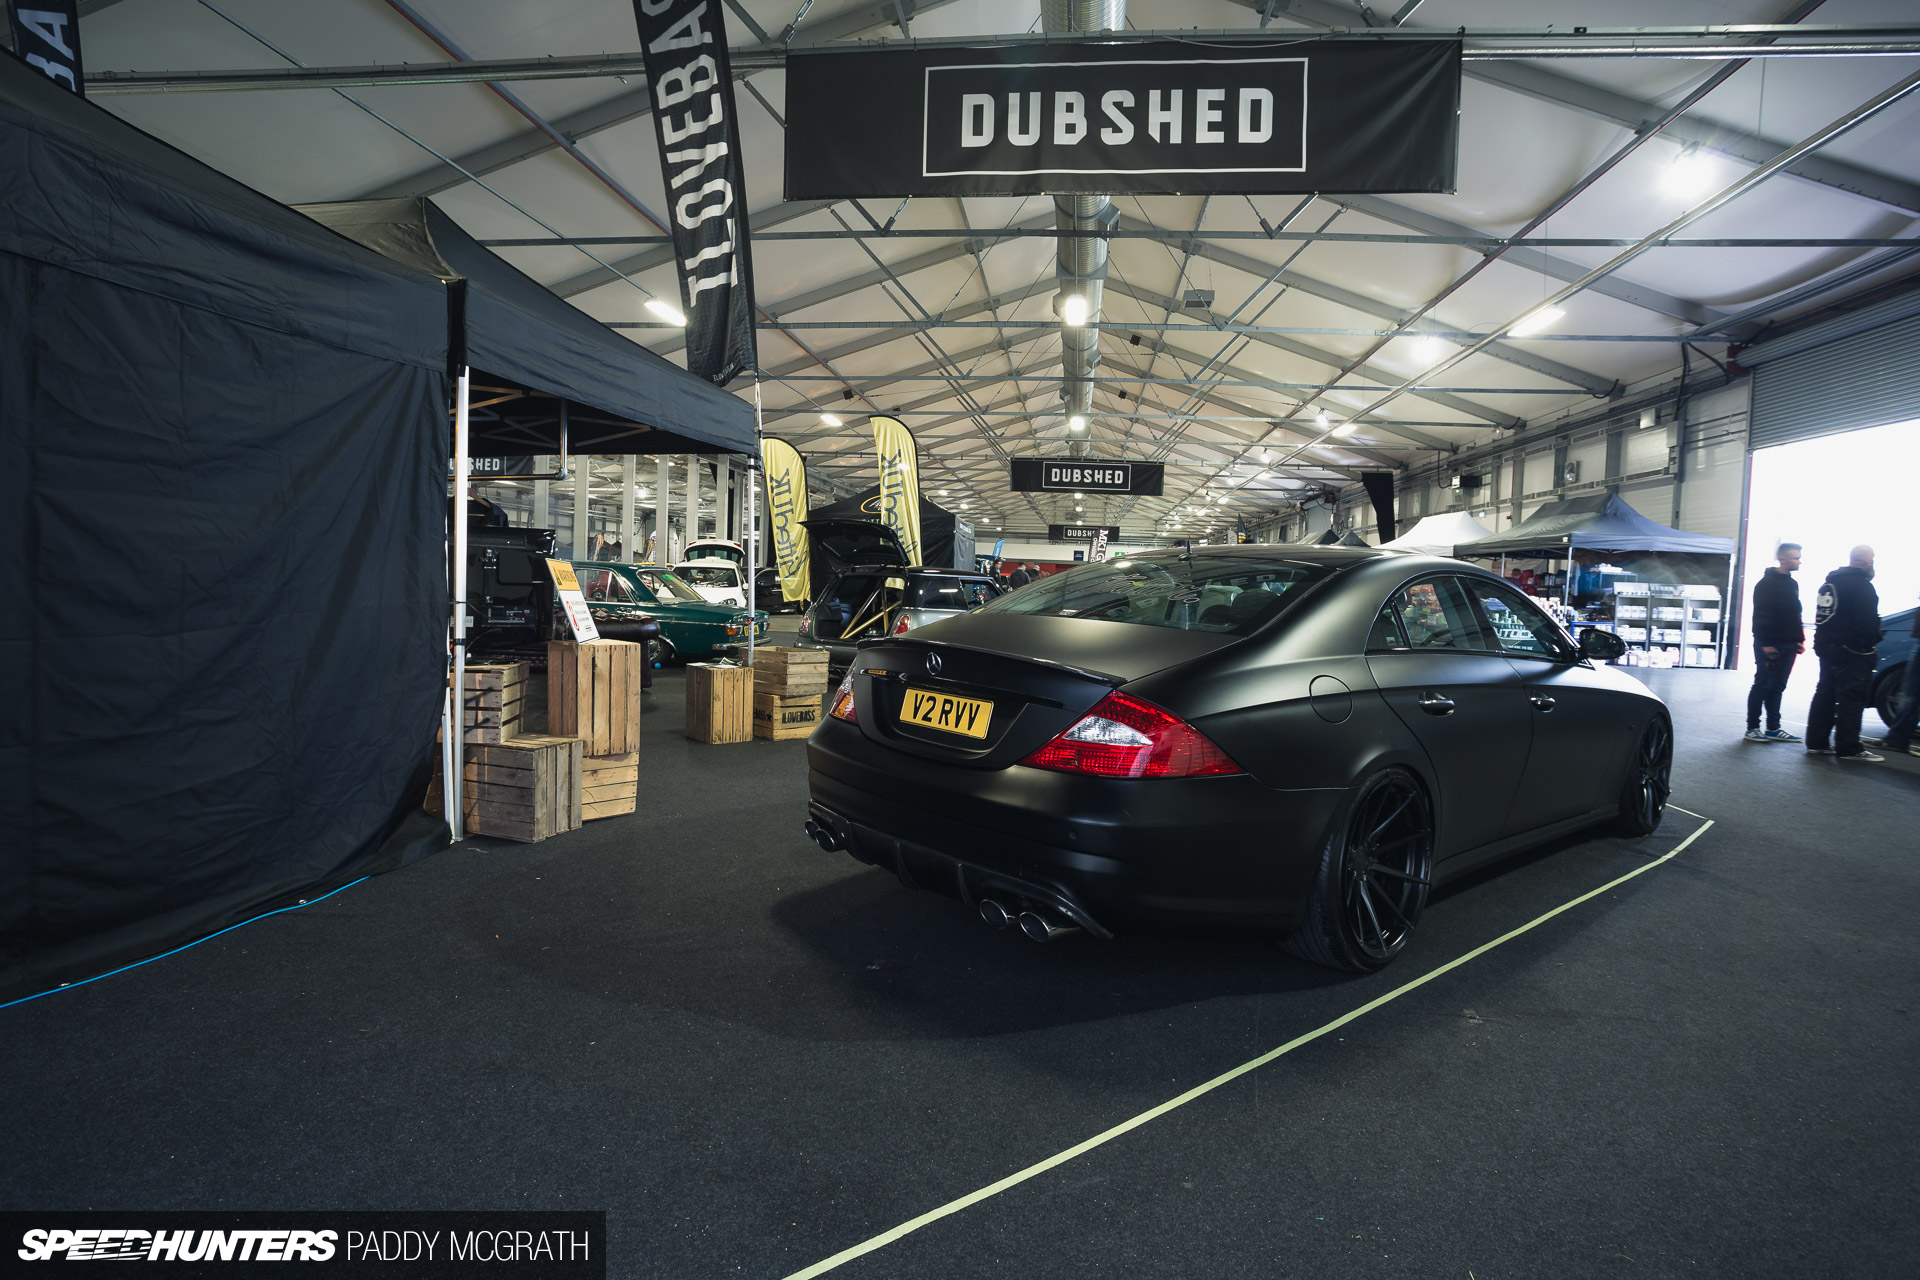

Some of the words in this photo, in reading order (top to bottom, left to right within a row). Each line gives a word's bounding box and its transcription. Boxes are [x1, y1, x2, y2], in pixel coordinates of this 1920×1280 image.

[961, 87, 1274, 148] DUBSHED
[1051, 468, 1124, 485] DUBSHED
[1067, 529, 1095, 537] DUBSH
[781, 709, 816, 724] ILOVEBASS
[913, 693, 936, 723] V2
[938, 699, 980, 731] RVV
